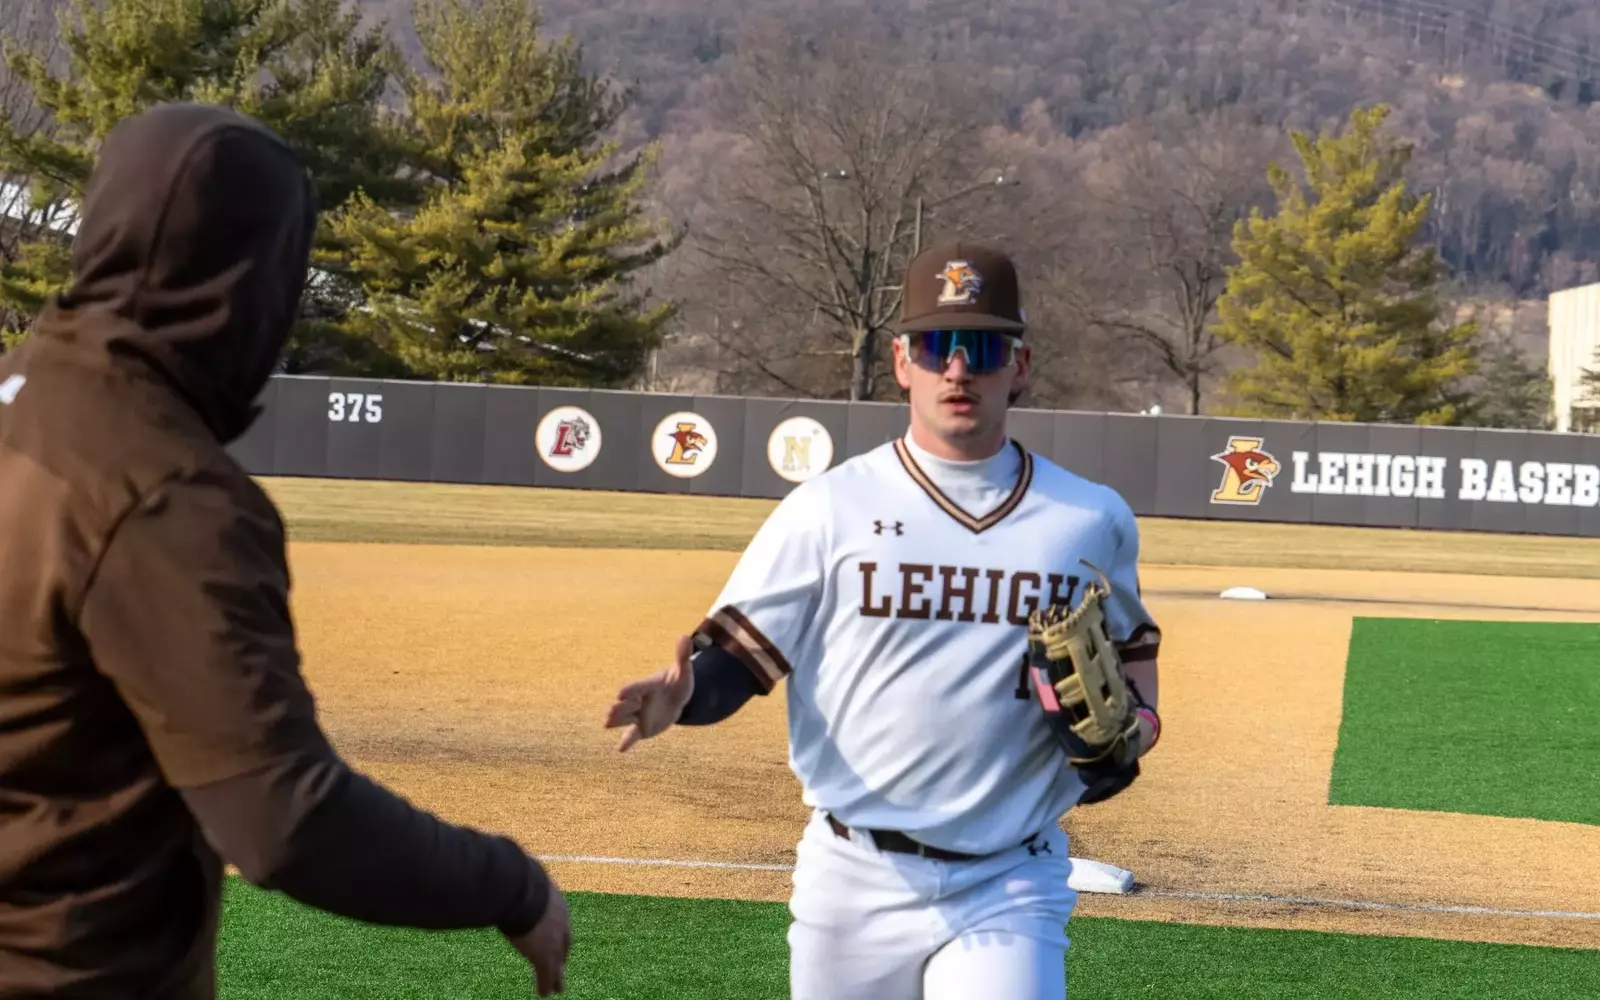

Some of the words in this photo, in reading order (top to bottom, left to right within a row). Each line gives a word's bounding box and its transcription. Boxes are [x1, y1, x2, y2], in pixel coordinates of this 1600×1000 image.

[328, 391, 383, 424] 375
[550, 424, 573, 457] L
[782, 435, 812, 471] N
[1291, 451, 1447, 499] LEHIGH
[1459, 457, 1600, 508] BASEB
